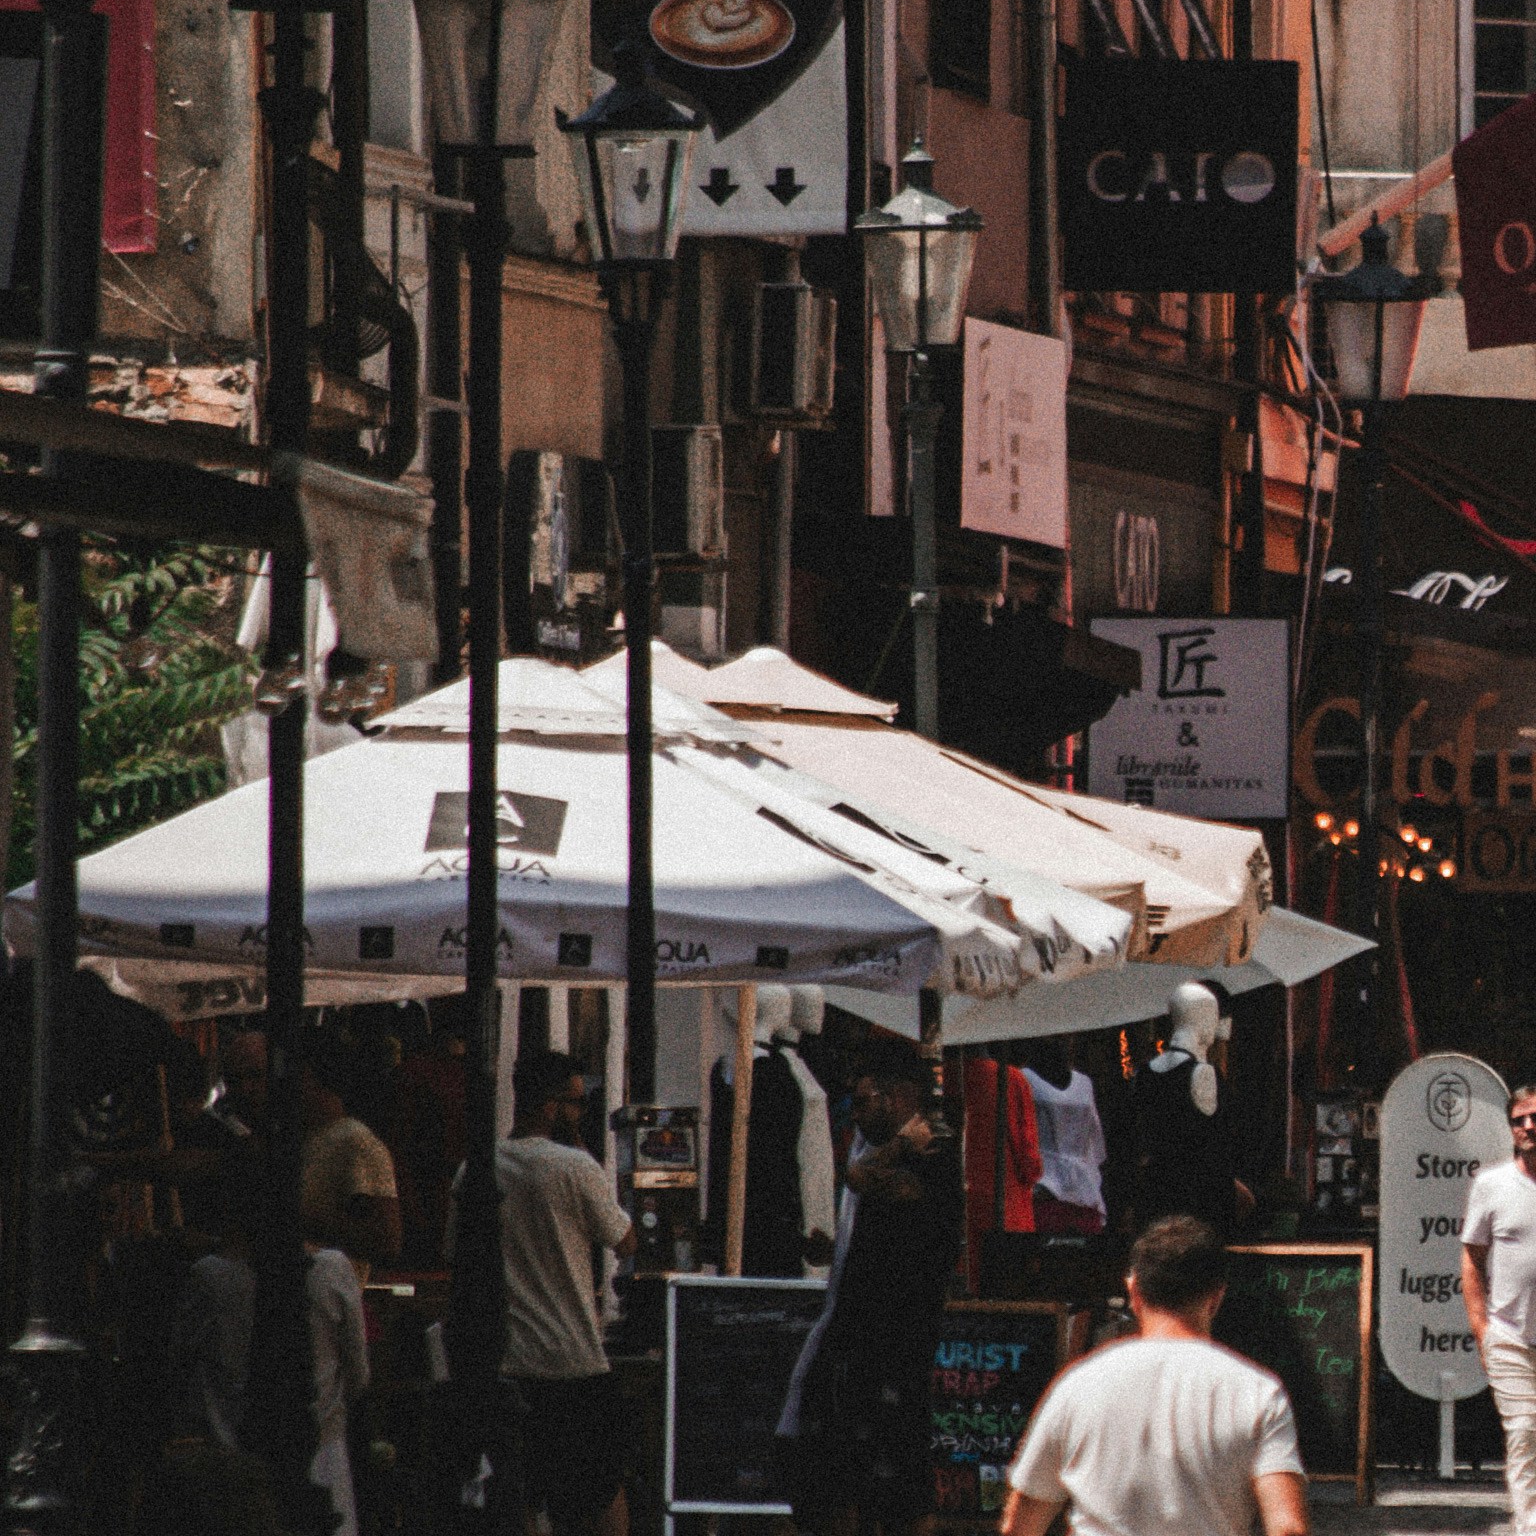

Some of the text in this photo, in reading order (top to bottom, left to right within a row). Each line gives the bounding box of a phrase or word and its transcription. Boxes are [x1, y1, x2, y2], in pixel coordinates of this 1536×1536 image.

[1157, 627, 1225, 699] 匠
[1177, 721, 1200, 748] &
[1293, 689, 1500, 808] Old
[1415, 1153, 1481, 1179] Store
[1420, 1216, 1465, 1244] you
[1399, 1267, 1465, 1303] lugga
[1419, 1327, 1477, 1353] here
[934, 1340, 1029, 1373] URIST
